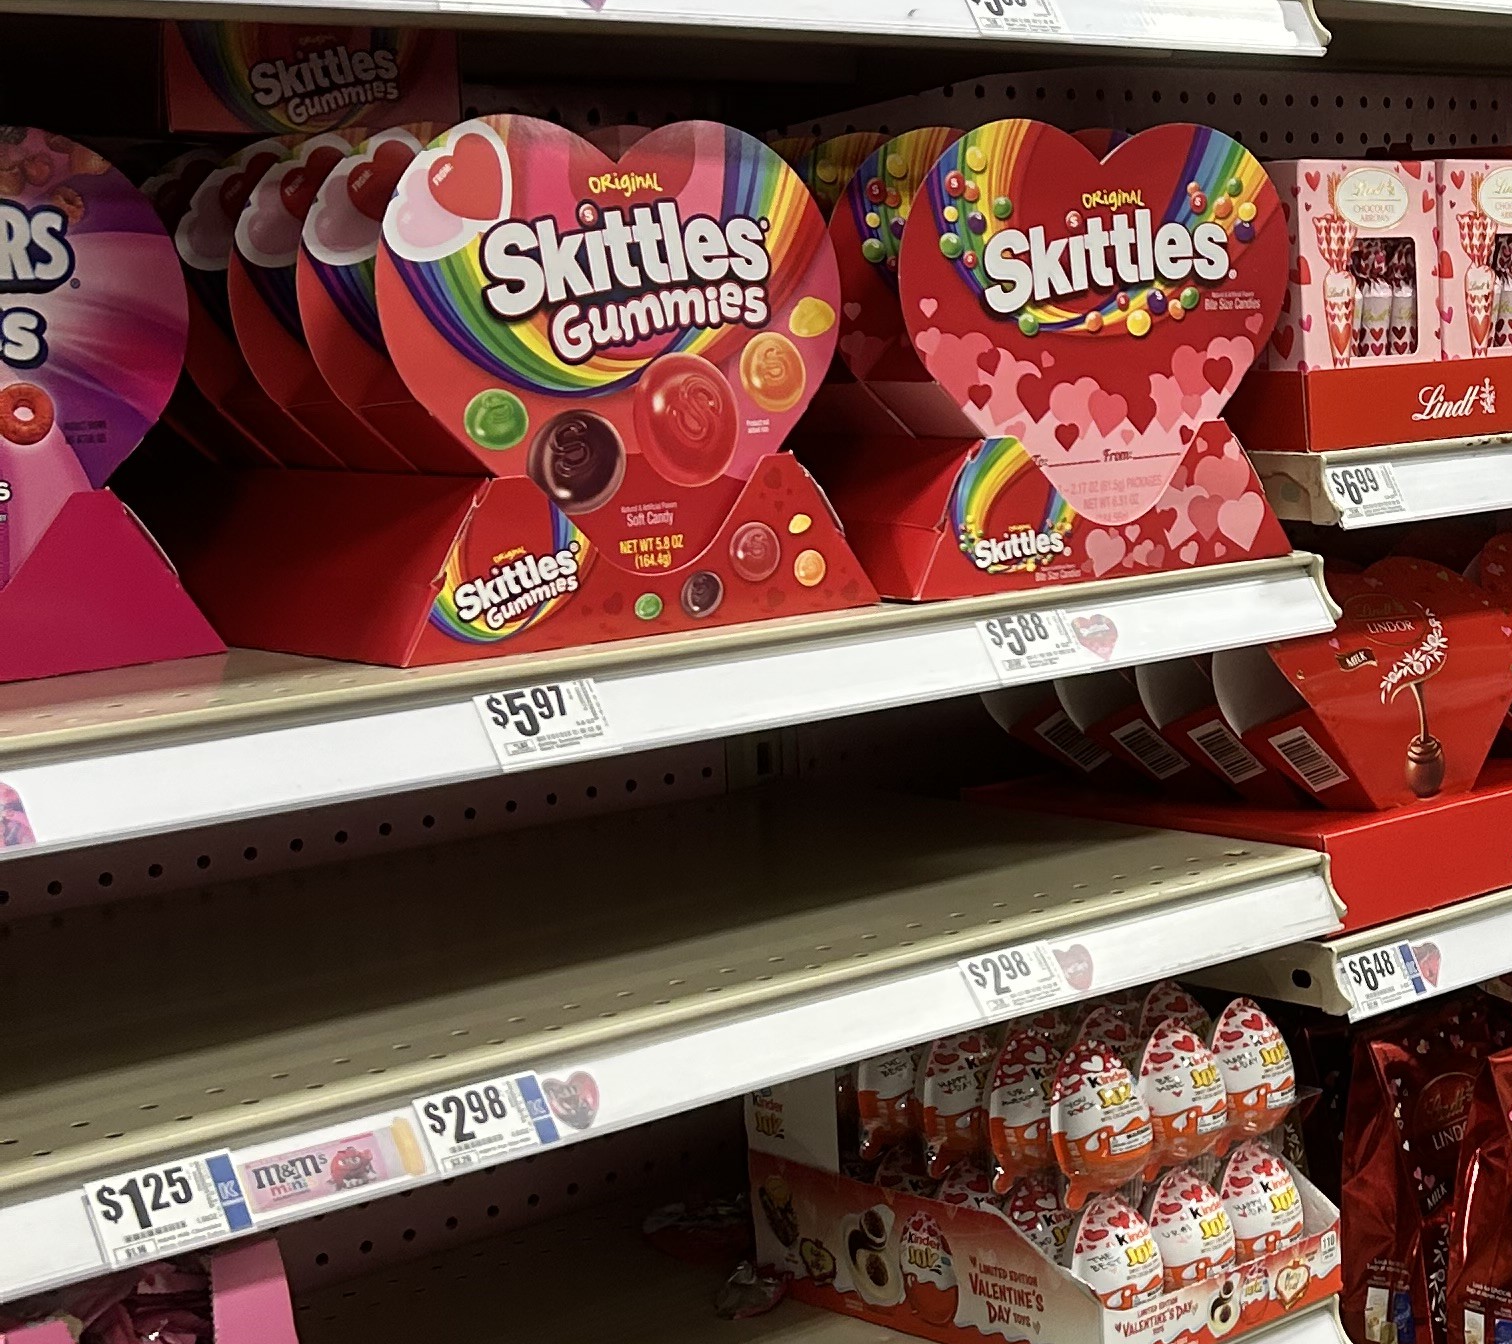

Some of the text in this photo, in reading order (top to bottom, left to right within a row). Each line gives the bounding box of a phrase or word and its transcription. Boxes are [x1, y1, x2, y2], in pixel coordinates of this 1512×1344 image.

[484, 201, 769, 315] Skittles
[984, 209, 1229, 314] Skittles
[553, 284, 768, 360] Gummies
[1412, 383, 1480, 421] Lindt
[627, 510, 674, 527] Soft Candy
[619, 535, 684, 554] NET WT 5.8 OZ
[975, 530, 1064, 569] Skittles
[454, 549, 579, 621] Skittles
[486, 575, 578, 629] Gummies
[1366, 618, 1416, 634] LINDOR
[1345, 651, 1369, 667] MILK
[1122, 1308, 1174, 1337] VALENTINE'S
